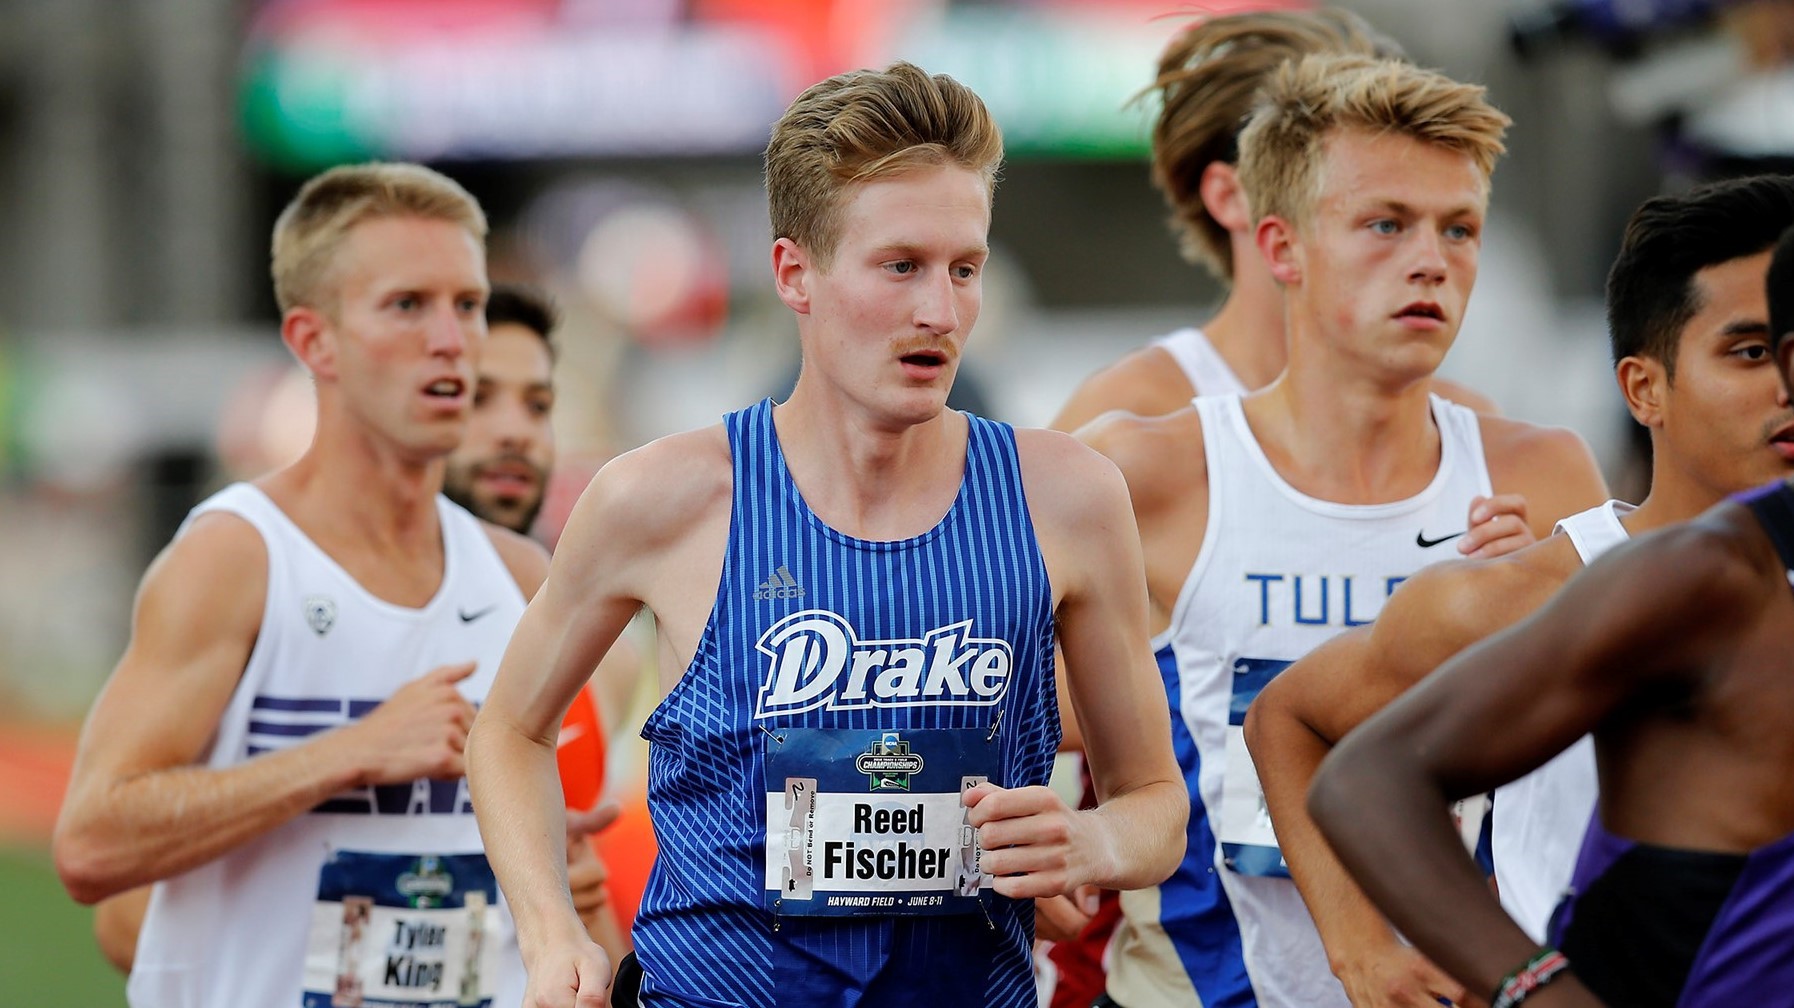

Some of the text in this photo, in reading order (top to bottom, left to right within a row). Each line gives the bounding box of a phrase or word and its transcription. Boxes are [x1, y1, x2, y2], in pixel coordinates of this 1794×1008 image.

[752, 587, 806, 600] adidas
[1244, 573, 1410, 627] TUL
[763, 617, 1010, 708] Drake
[863, 760, 918, 769] CHAMPIONSHIPS
[854, 804, 924, 834] Reed
[806, 867, 812, 876] Do
[824, 841, 951, 879] Fischer
[827, 896, 870, 907] HAYWARD
[871, 896, 895, 907] FIELD
[907, 896, 928, 906] JUNE
[384, 956, 443, 992] King
